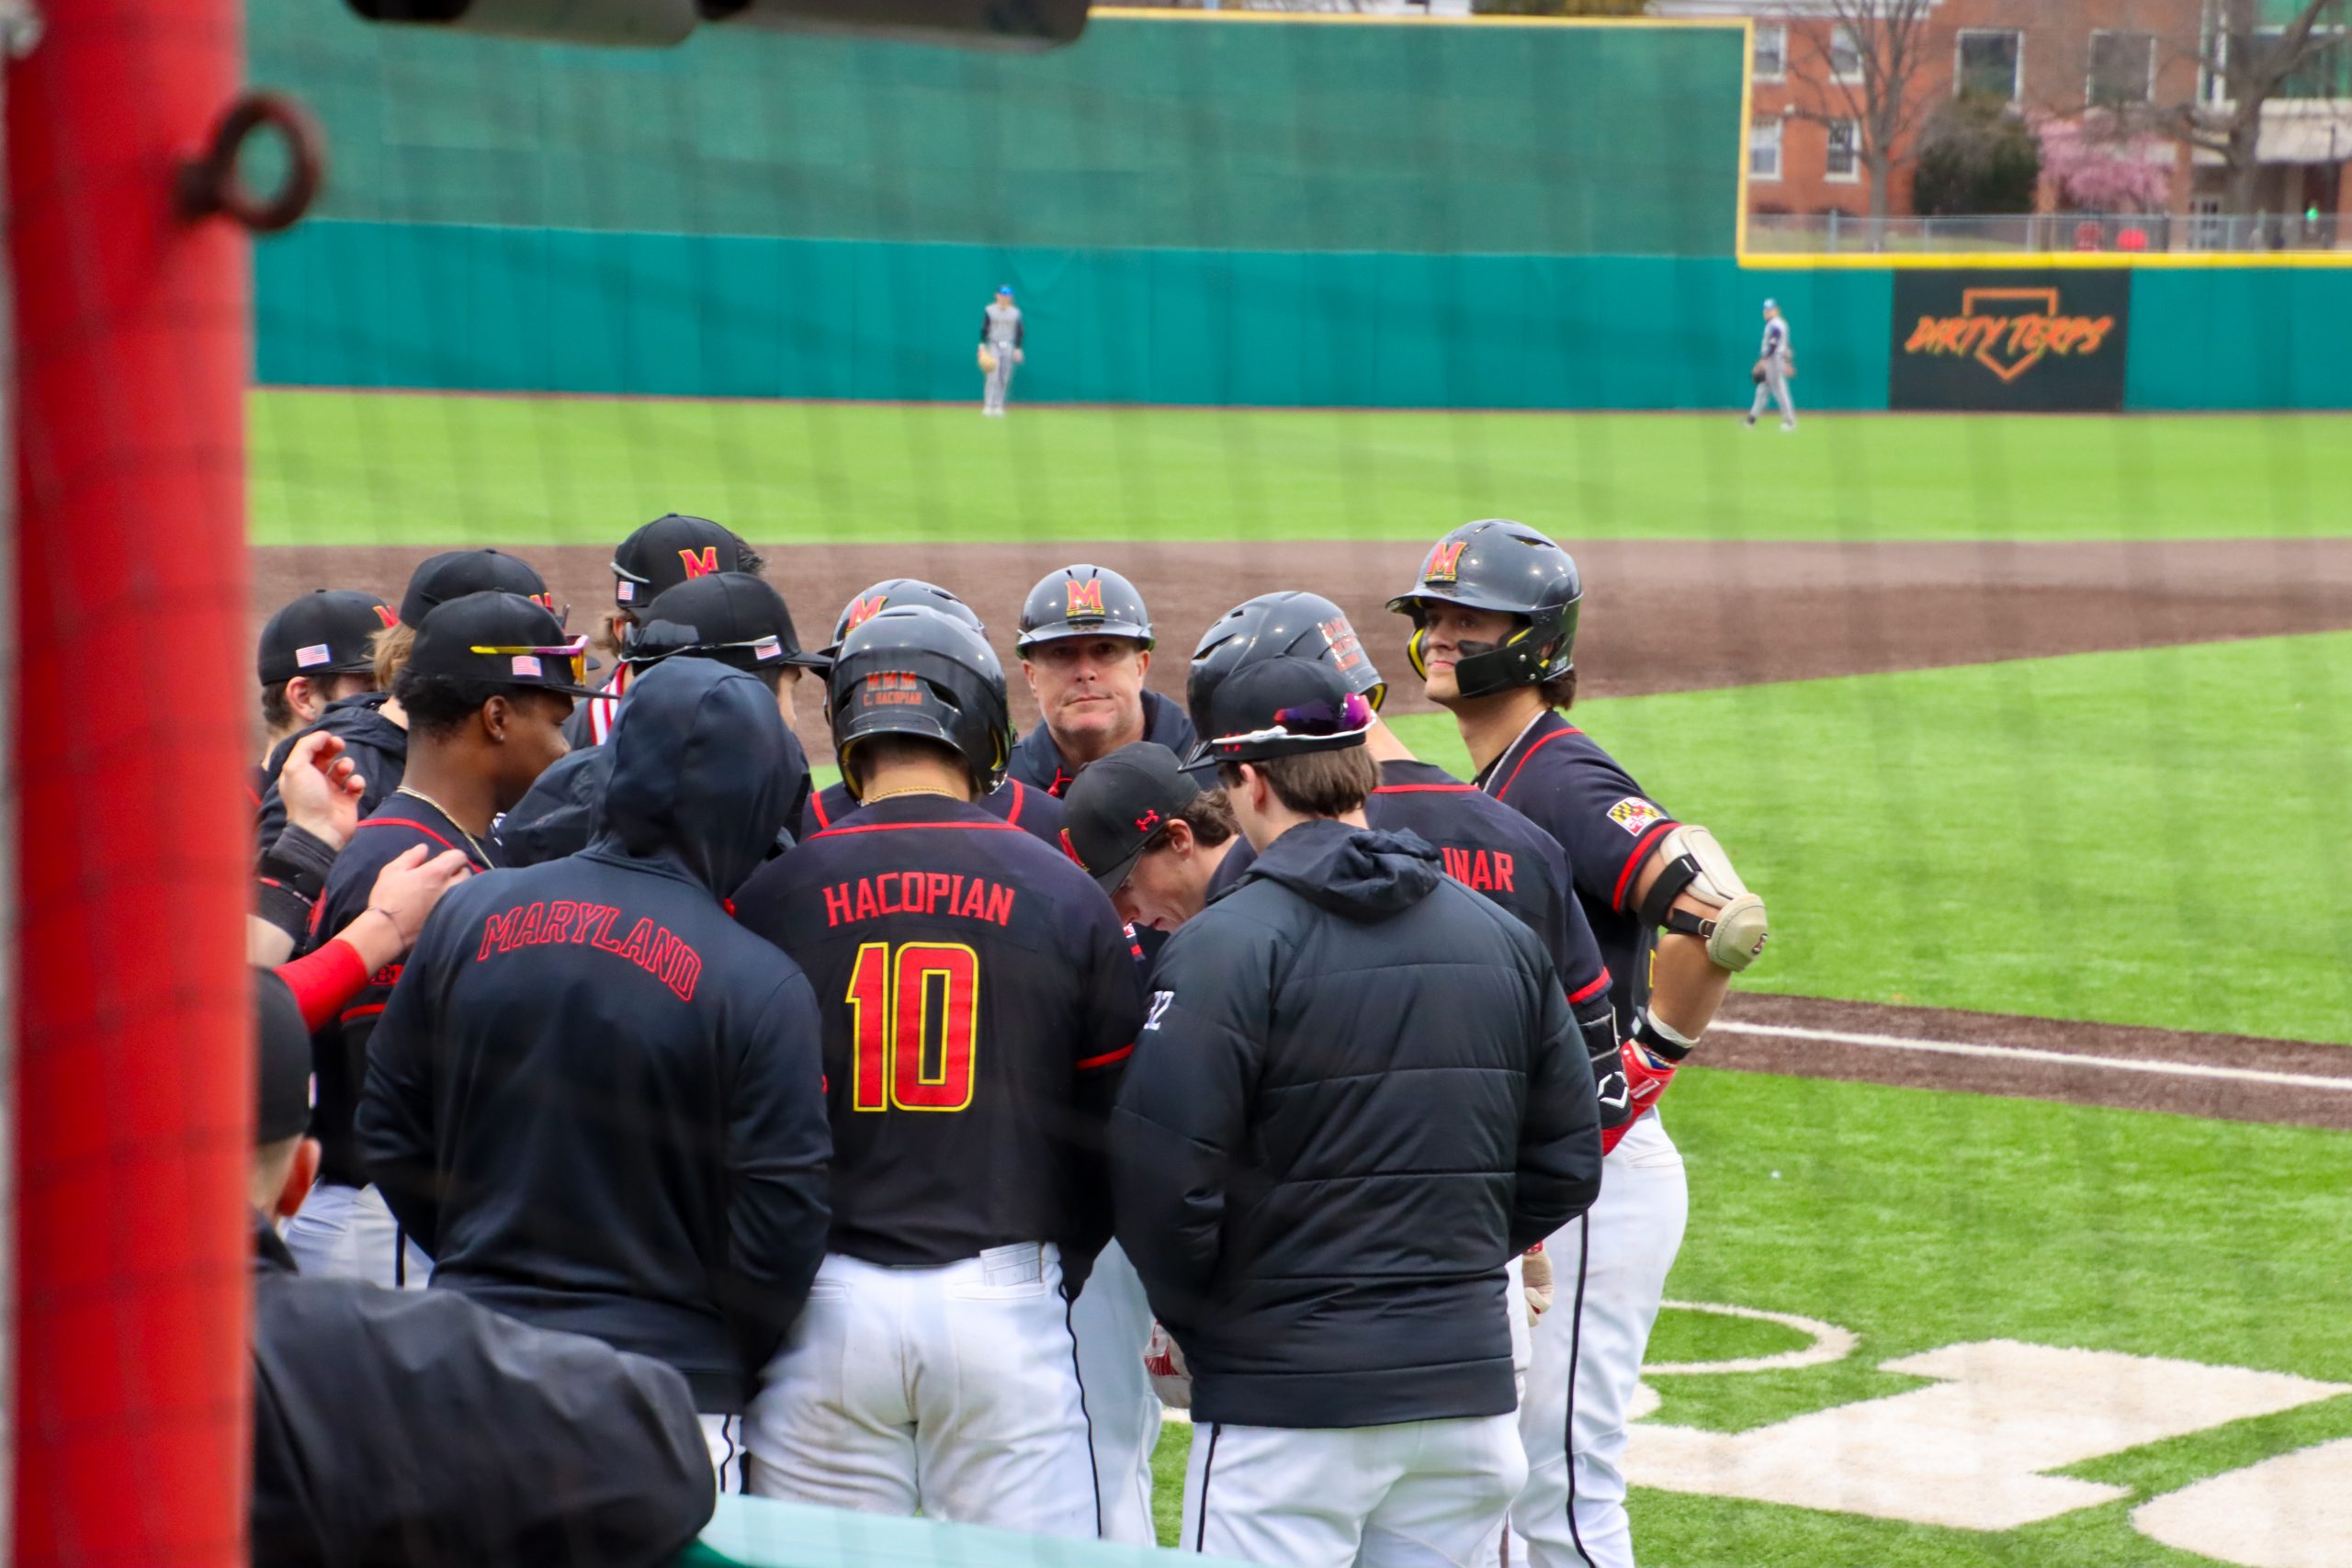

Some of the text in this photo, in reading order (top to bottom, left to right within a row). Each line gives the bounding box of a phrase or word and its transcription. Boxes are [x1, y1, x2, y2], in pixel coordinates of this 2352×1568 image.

[1905, 313, 2115, 356] DIRTY TERPS
[677, 547, 719, 581] M
[1425, 541, 1468, 579] M
[1065, 578, 1105, 613] M
[1440, 847, 1515, 893] INAR
[822, 872, 1015, 927] HACOPIAN
[477, 900, 703, 1002] MARYLAND
[845, 941, 979, 1112] 10
